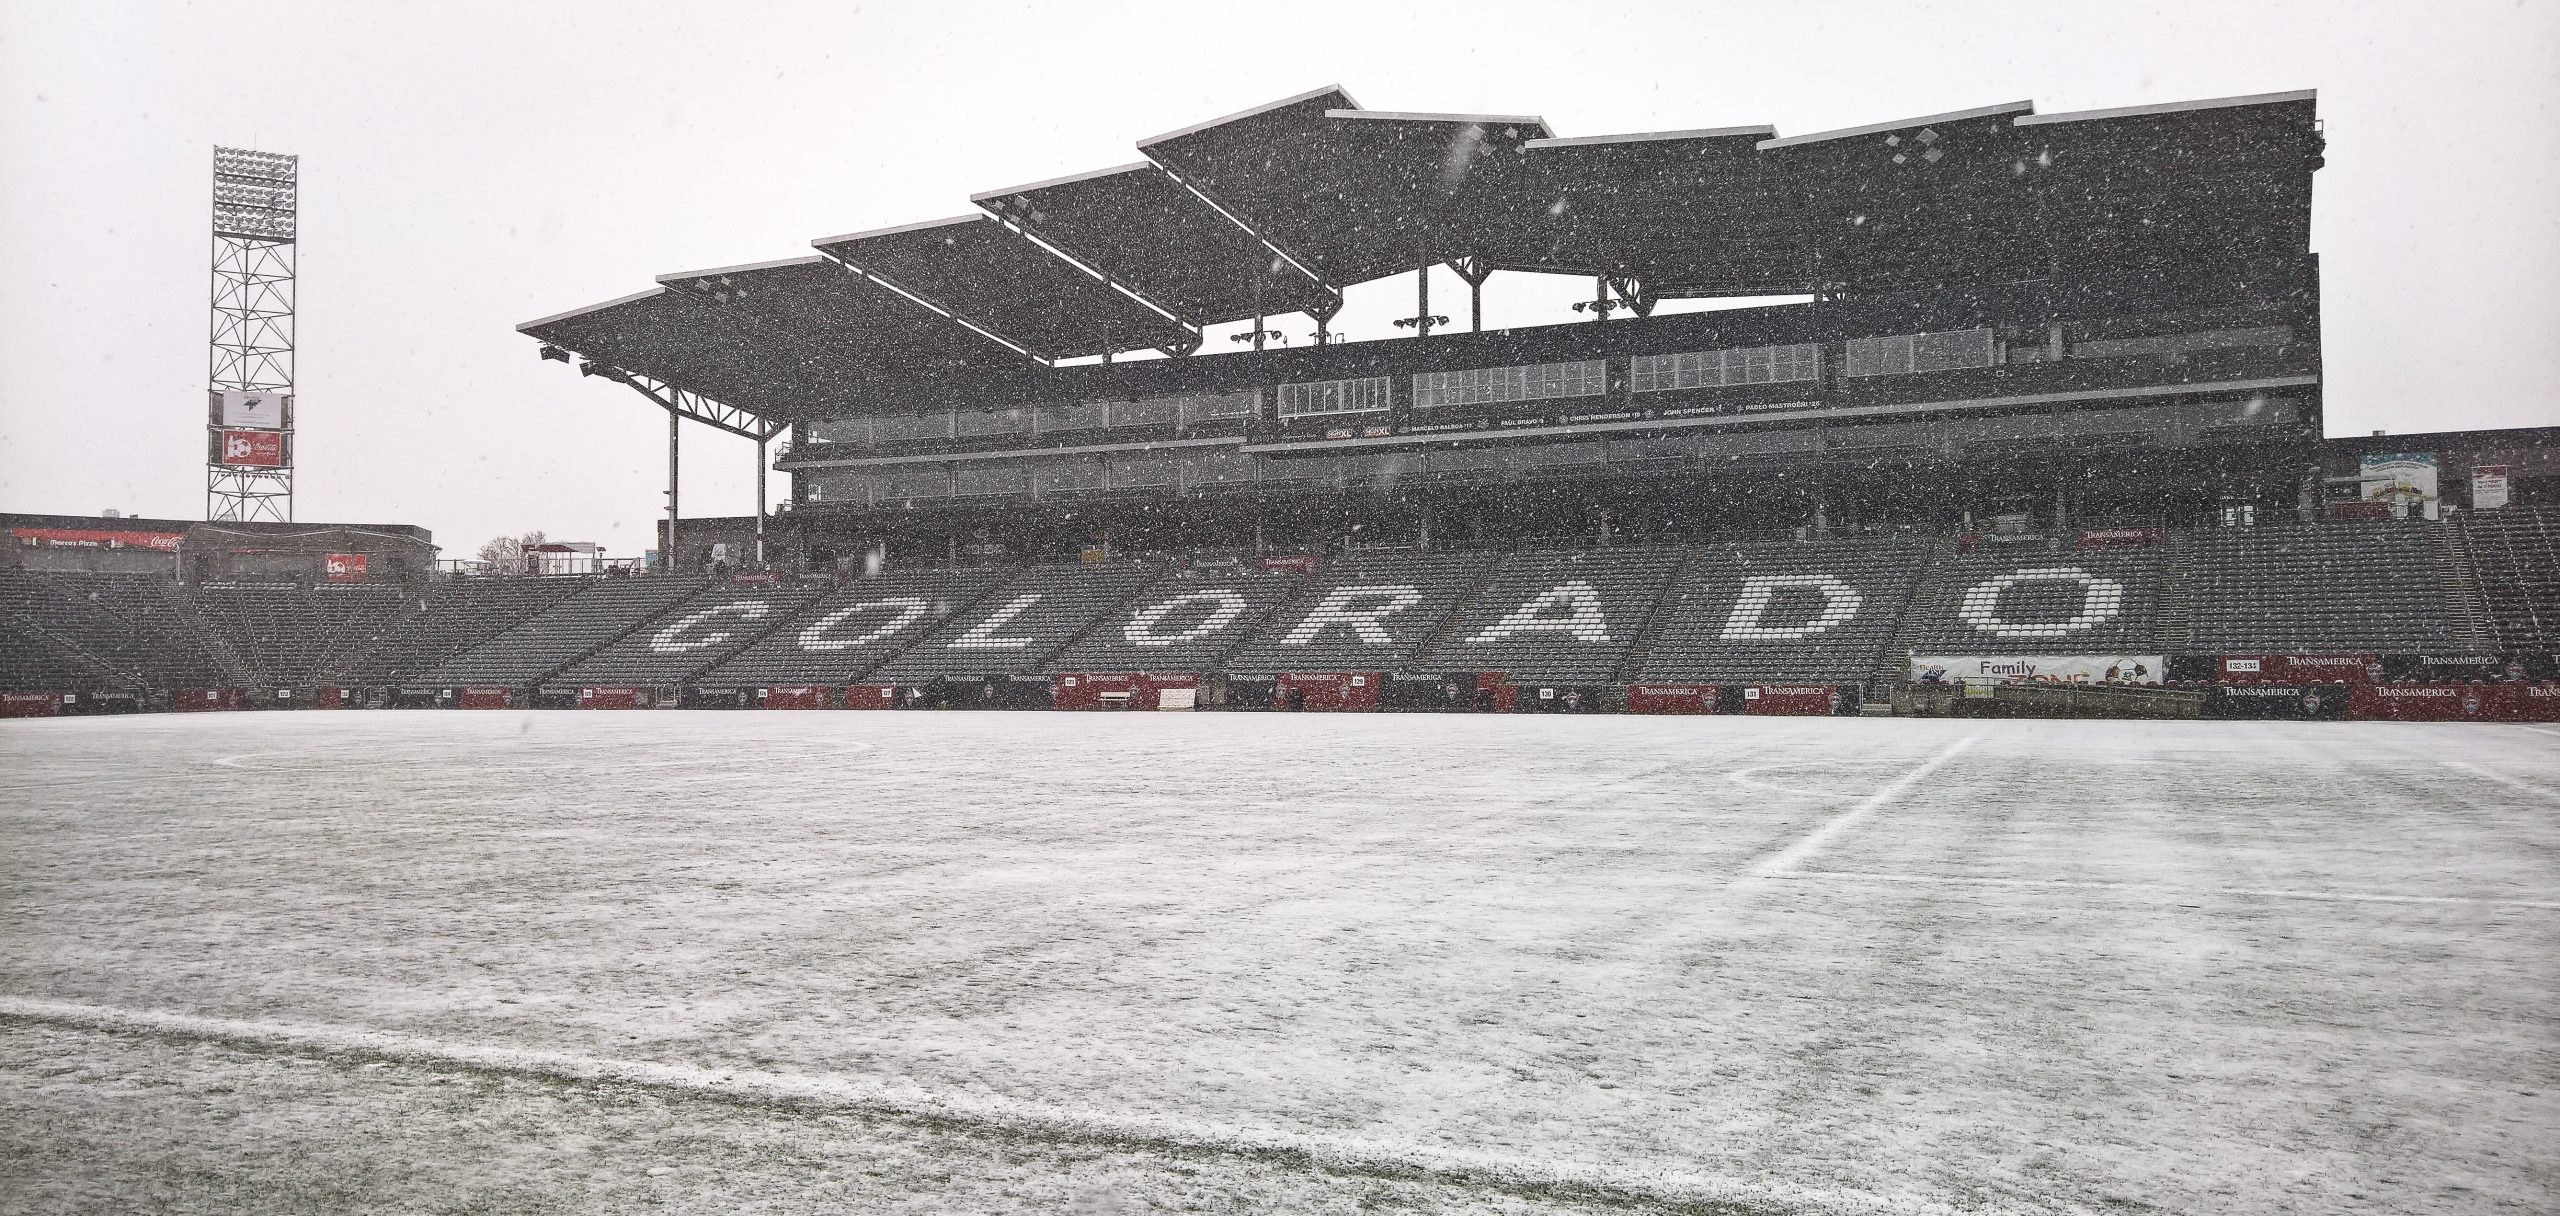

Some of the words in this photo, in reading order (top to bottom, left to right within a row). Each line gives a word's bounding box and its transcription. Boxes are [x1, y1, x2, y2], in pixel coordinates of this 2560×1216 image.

[1663, 408, 1681, 416] JOHN
[2087, 531, 2143, 539] TRANSAMERICA
[649, 567, 2124, 654] COLORADO
[2287, 656, 2363, 666] TRANSAMERICA
[2420, 655, 2499, 665] TRANSAMERICA
[1980, 660, 2036, 678] Family
[2229, 662, 2257, 670] 132-134
[1229, 673, 1276, 682] TRANSAMERICA
[1639, 687, 1698, 695] TRANSAMERICA
[1765, 687, 1824, 695] TRANSAMERICA
[2224, 687, 2300, 696] TRANSAMERICA
[2376, 687, 2457, 697] TRANSAMERICA
